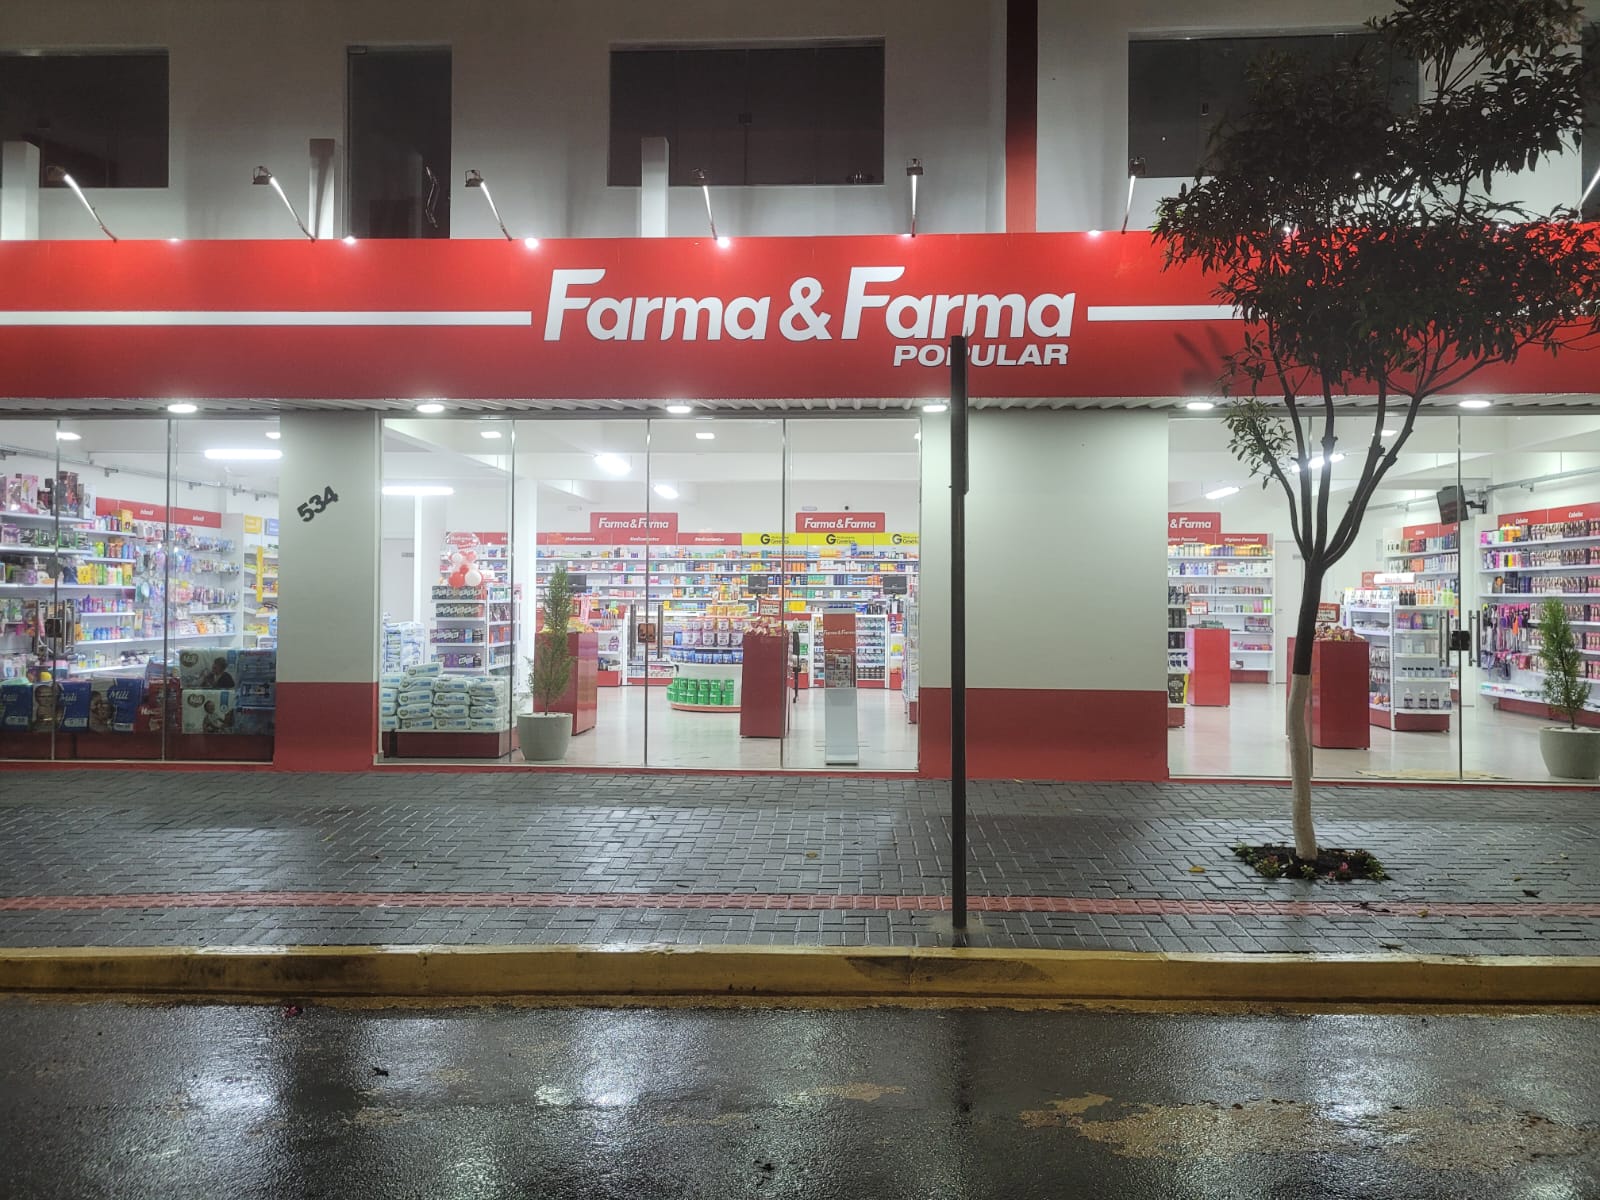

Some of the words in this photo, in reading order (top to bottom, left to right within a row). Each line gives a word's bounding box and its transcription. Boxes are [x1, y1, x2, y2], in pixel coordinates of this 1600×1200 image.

[544, 268, 770, 341] Farma
[779, 276, 832, 341] &
[841, 266, 1075, 340] Farma
[297, 486, 339, 522] 534
[598, 517, 629, 529] Farma
[630, 519, 638, 529] &
[804, 517, 836, 529] Farma
[836, 519, 844, 529] &
[844, 517, 876, 529] Farma
[1169, 519, 1178, 529] &
[1179, 517, 1212, 529] Farma
[760, 533, 771, 545] G
[826, 533, 836, 545] G
[892, 533, 902, 545] G
